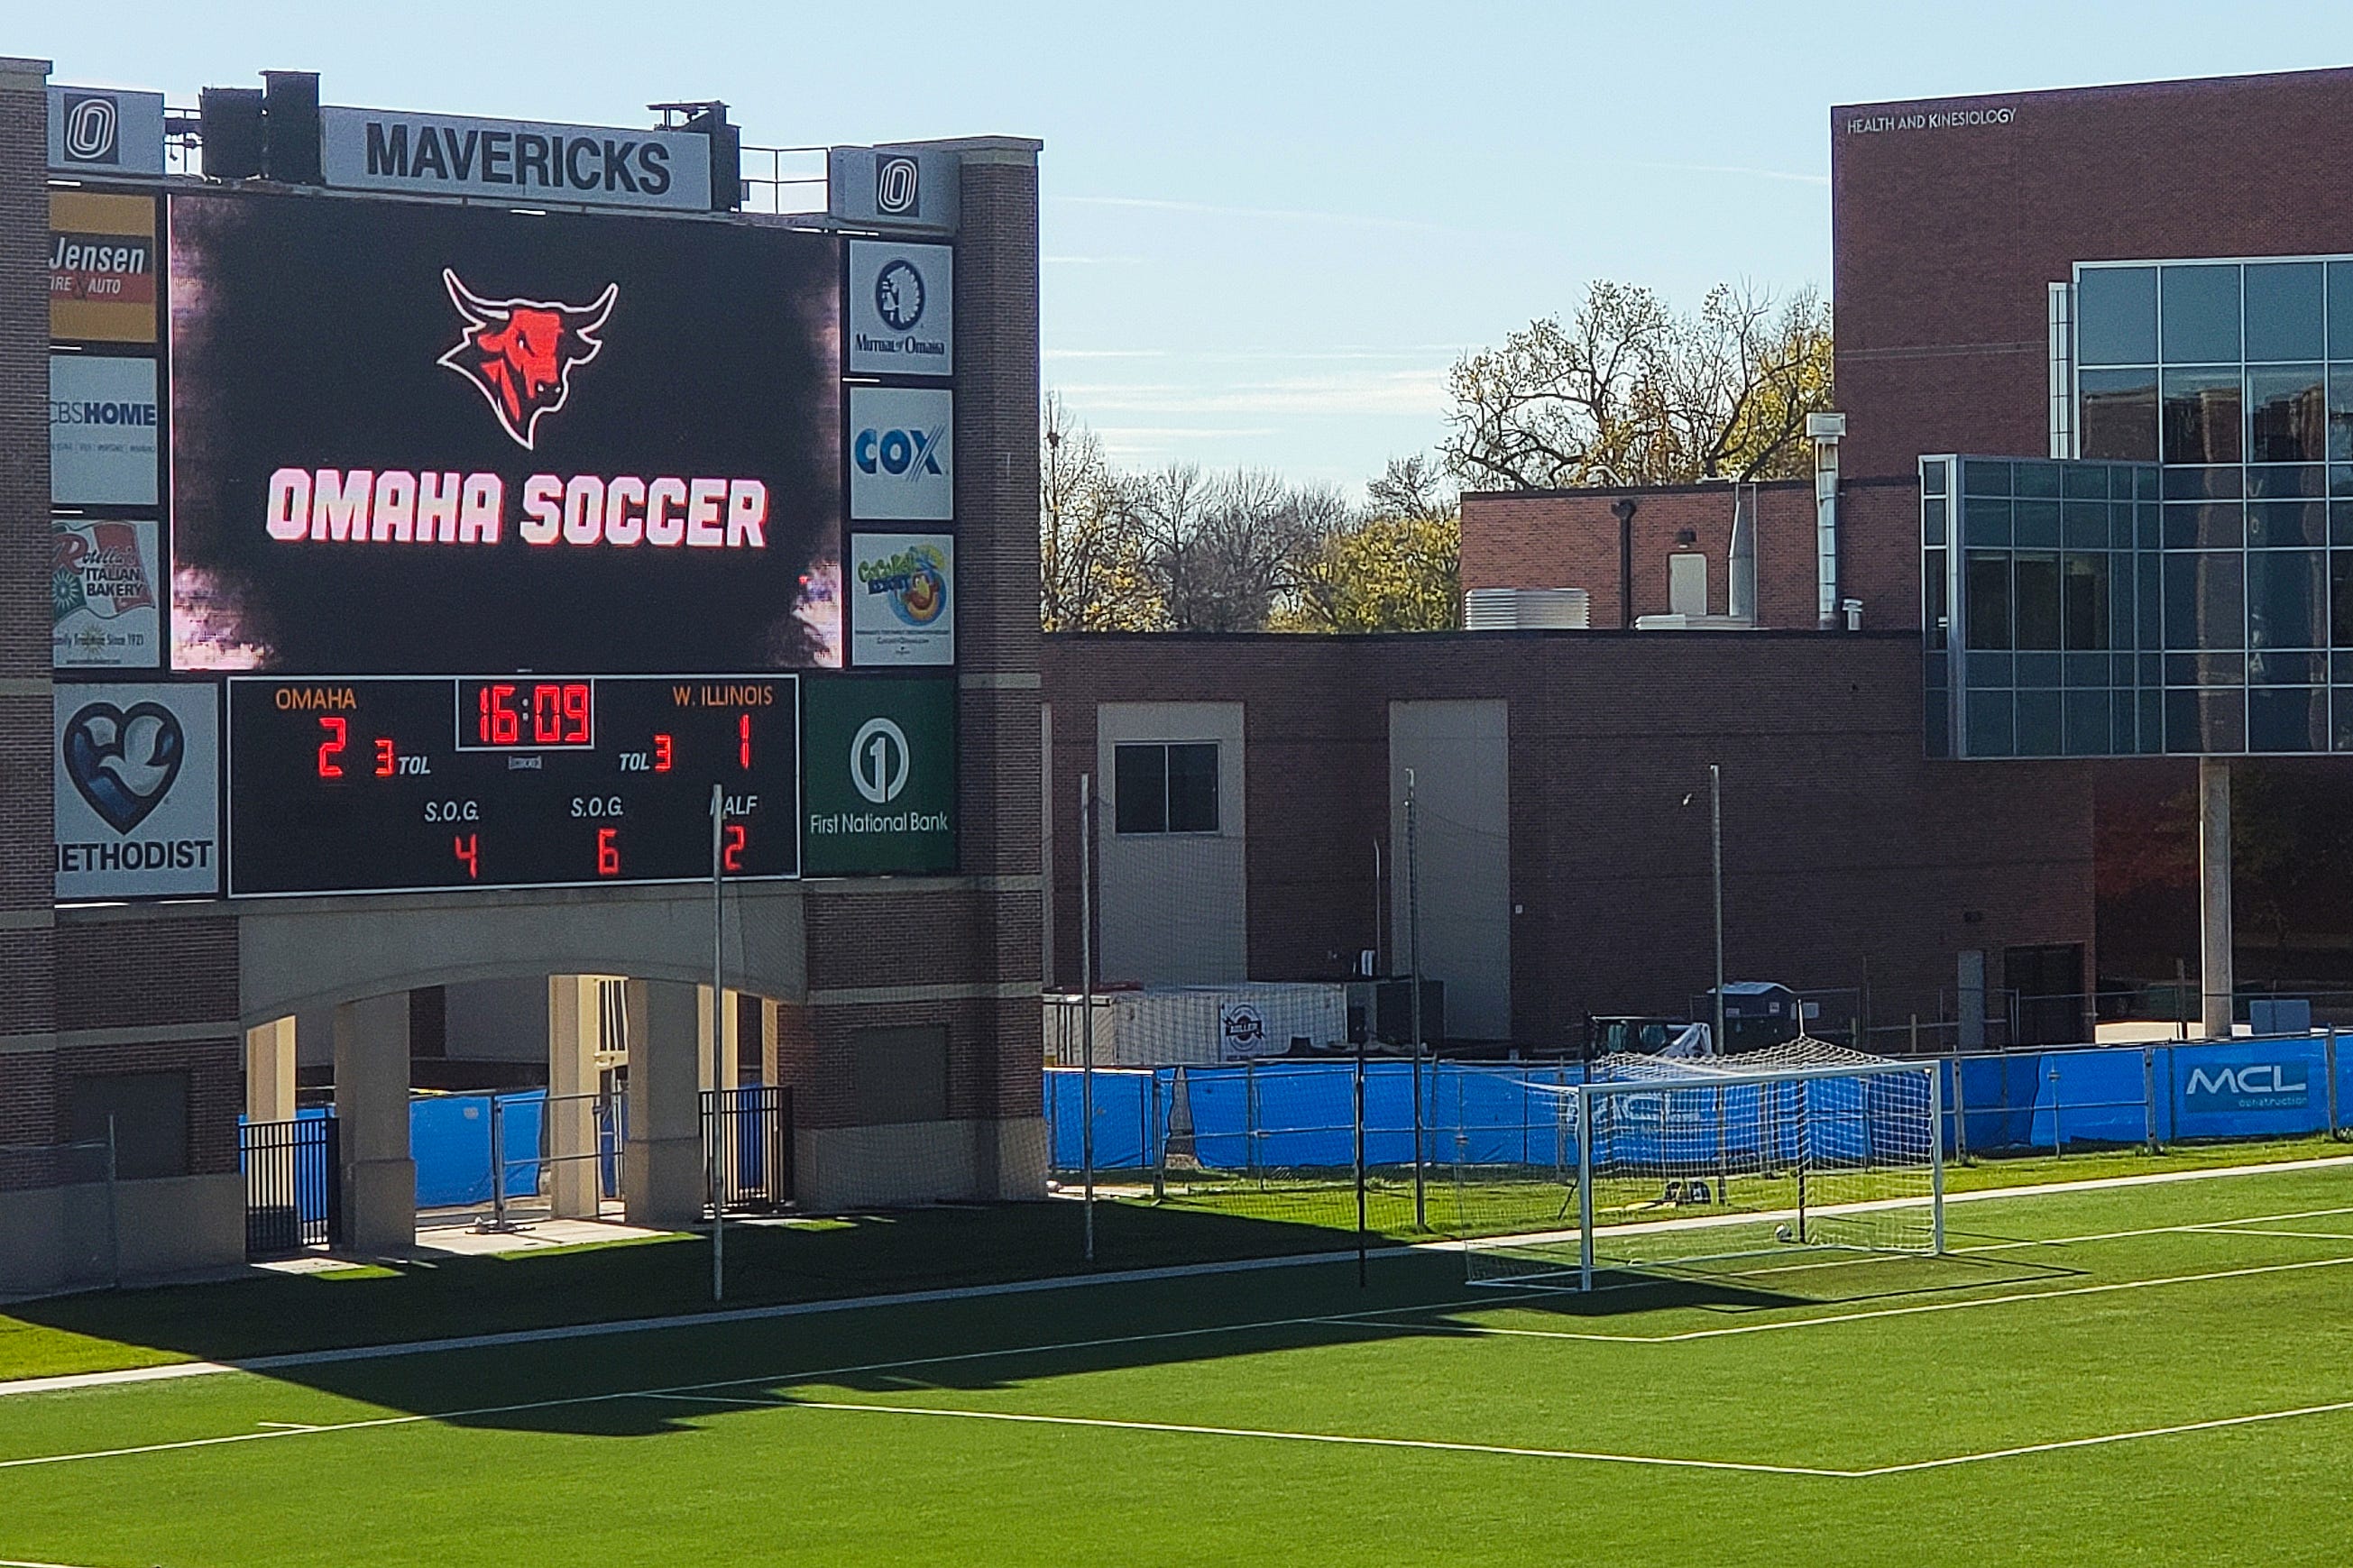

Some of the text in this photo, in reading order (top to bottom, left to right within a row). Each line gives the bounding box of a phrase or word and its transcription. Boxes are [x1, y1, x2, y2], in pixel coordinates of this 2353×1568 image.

[1847, 107, 2017, 134] HEALTH AND KINESIOLOGY
[365, 121, 672, 196] MAVERICKS
[49, 236, 144, 274] Jensen
[87, 278, 121, 294] AUTO
[854, 425, 942, 482] COX
[266, 467, 768, 548] OMAHA SOCCER
[87, 567, 141, 582] ITALIAN
[87, 582, 143, 597] BAKERY
[275, 688, 356, 711] OMAHA
[479, 683, 590, 745] 16:09
[673, 684, 774, 707] W. ILLINOIS
[318, 718, 346, 778] 2
[374, 738, 431, 777] 3 TOL
[619, 734, 673, 773] TOL 3
[739, 714, 750, 770] 1
[810, 811, 949, 835] First National Bank
[55, 839, 214, 872] ETHODIST
[455, 833, 479, 880] 4
[597, 828, 620, 876] 6
[724, 825, 746, 871] 2
[2185, 1064, 2307, 1095] MCL
